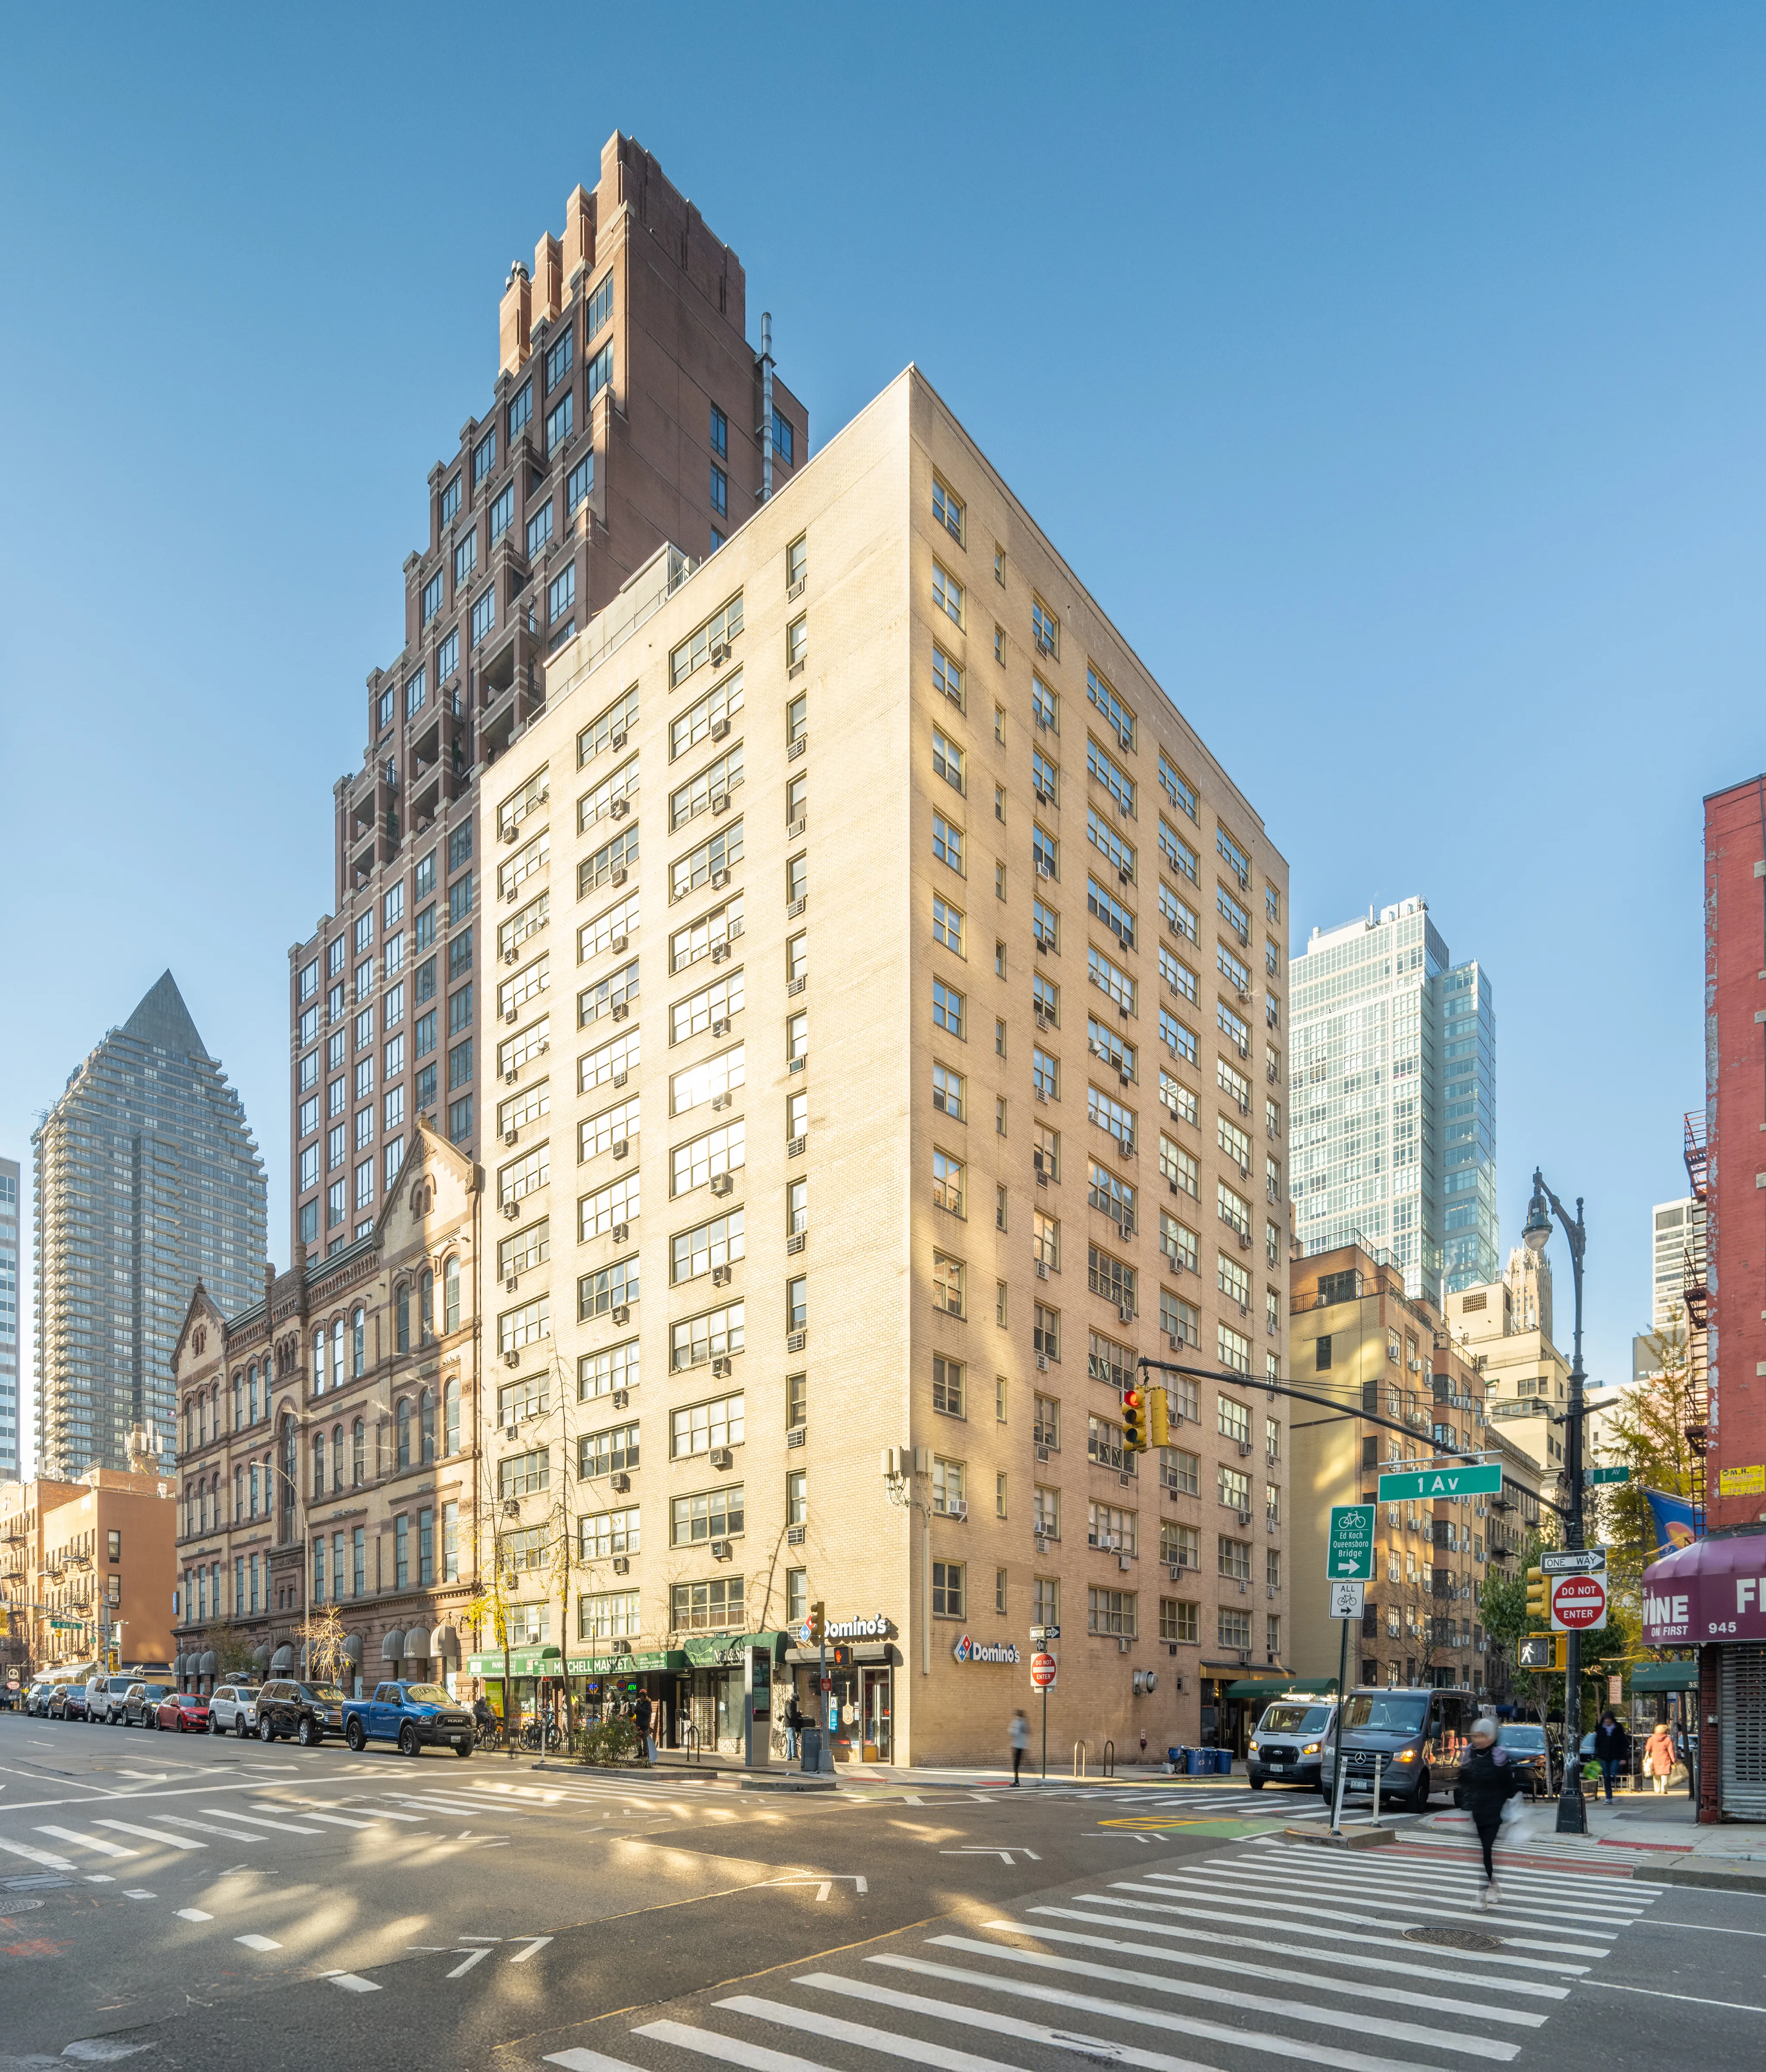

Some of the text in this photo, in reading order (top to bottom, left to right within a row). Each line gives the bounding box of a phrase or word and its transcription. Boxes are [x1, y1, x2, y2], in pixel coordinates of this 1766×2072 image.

[1602, 1470, 1606, 1481] 1
[1418, 1475, 1459, 1493] 1 Av
[1349, 1531, 1363, 1539] Koch
[1333, 1540, 1369, 1548] Queensboro
[1338, 1550, 1362, 1559] Bridge
[1547, 1556, 1596, 1567] ONE WAY
[1562, 1586, 1596, 1596] DO NOT
[1643, 1590, 1689, 1626] WINE
[1563, 1609, 1593, 1619] ENTER
[825, 1613, 887, 1638] Domino's
[1708, 1622, 1737, 1634] 945
[1651, 1626, 1689, 1637] ON FIRST
[713, 1649, 726, 1662] Nail
[728, 1649, 734, 1661] &
[973, 1642, 1020, 1663] Domino's
[554, 1658, 628, 1673] MICHELL MARKET
[685, 1656, 695, 1665] apple
